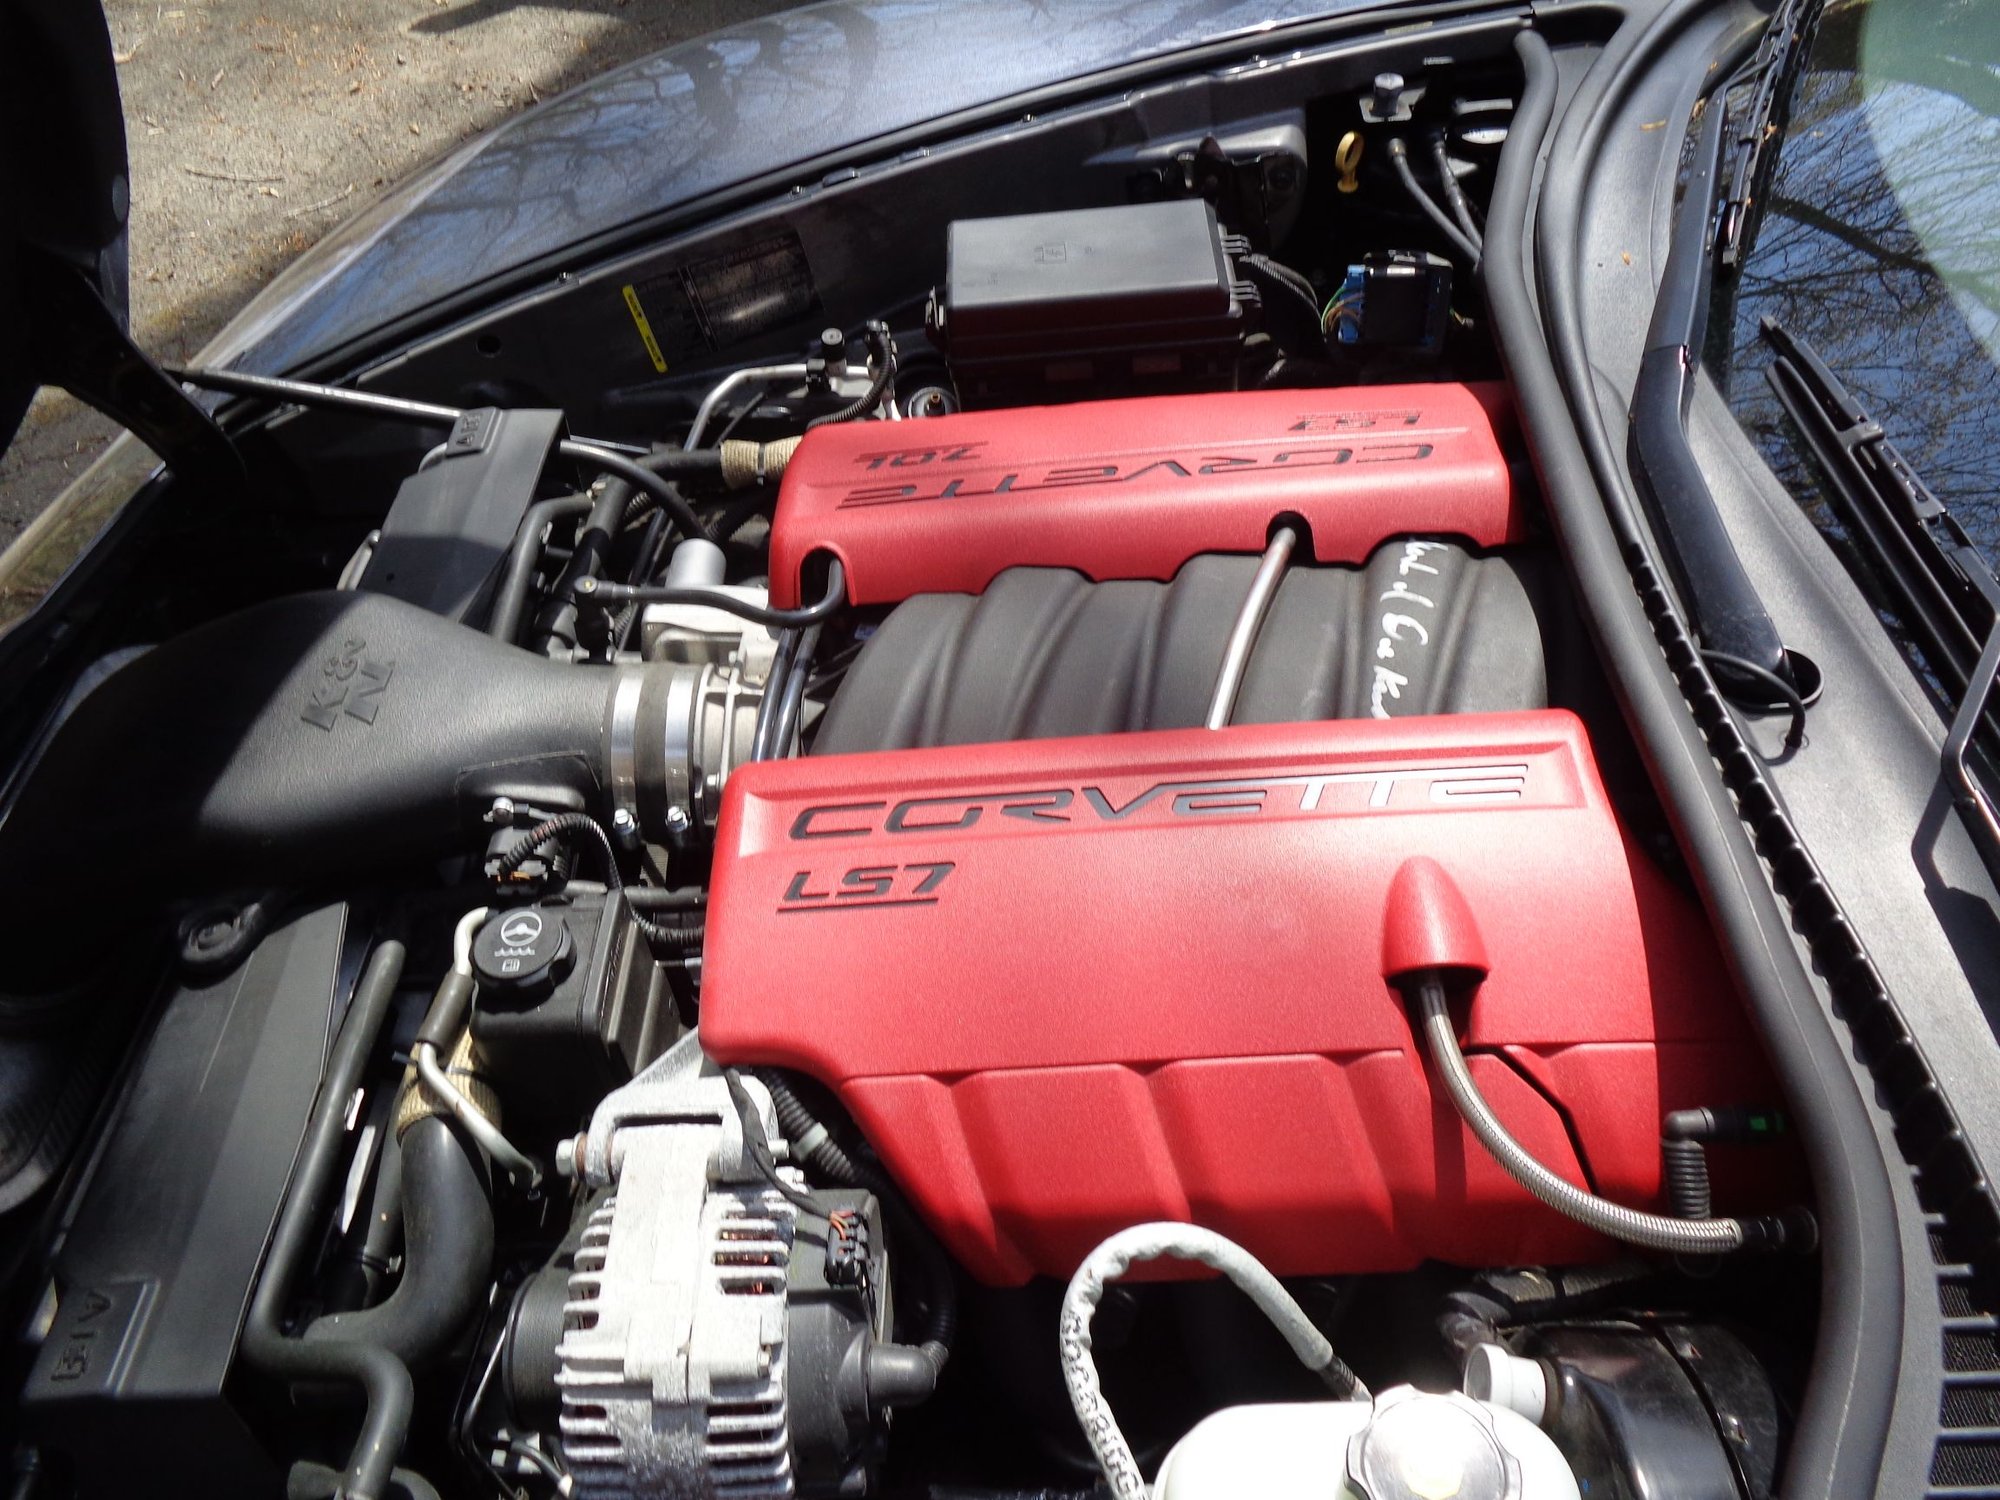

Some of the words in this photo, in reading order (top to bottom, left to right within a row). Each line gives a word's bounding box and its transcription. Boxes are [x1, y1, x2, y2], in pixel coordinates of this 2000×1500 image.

[836, 442, 1434, 510] CORVETTE
[789, 764, 1528, 840] CORVETTE
[783, 861, 955, 904] LS7
